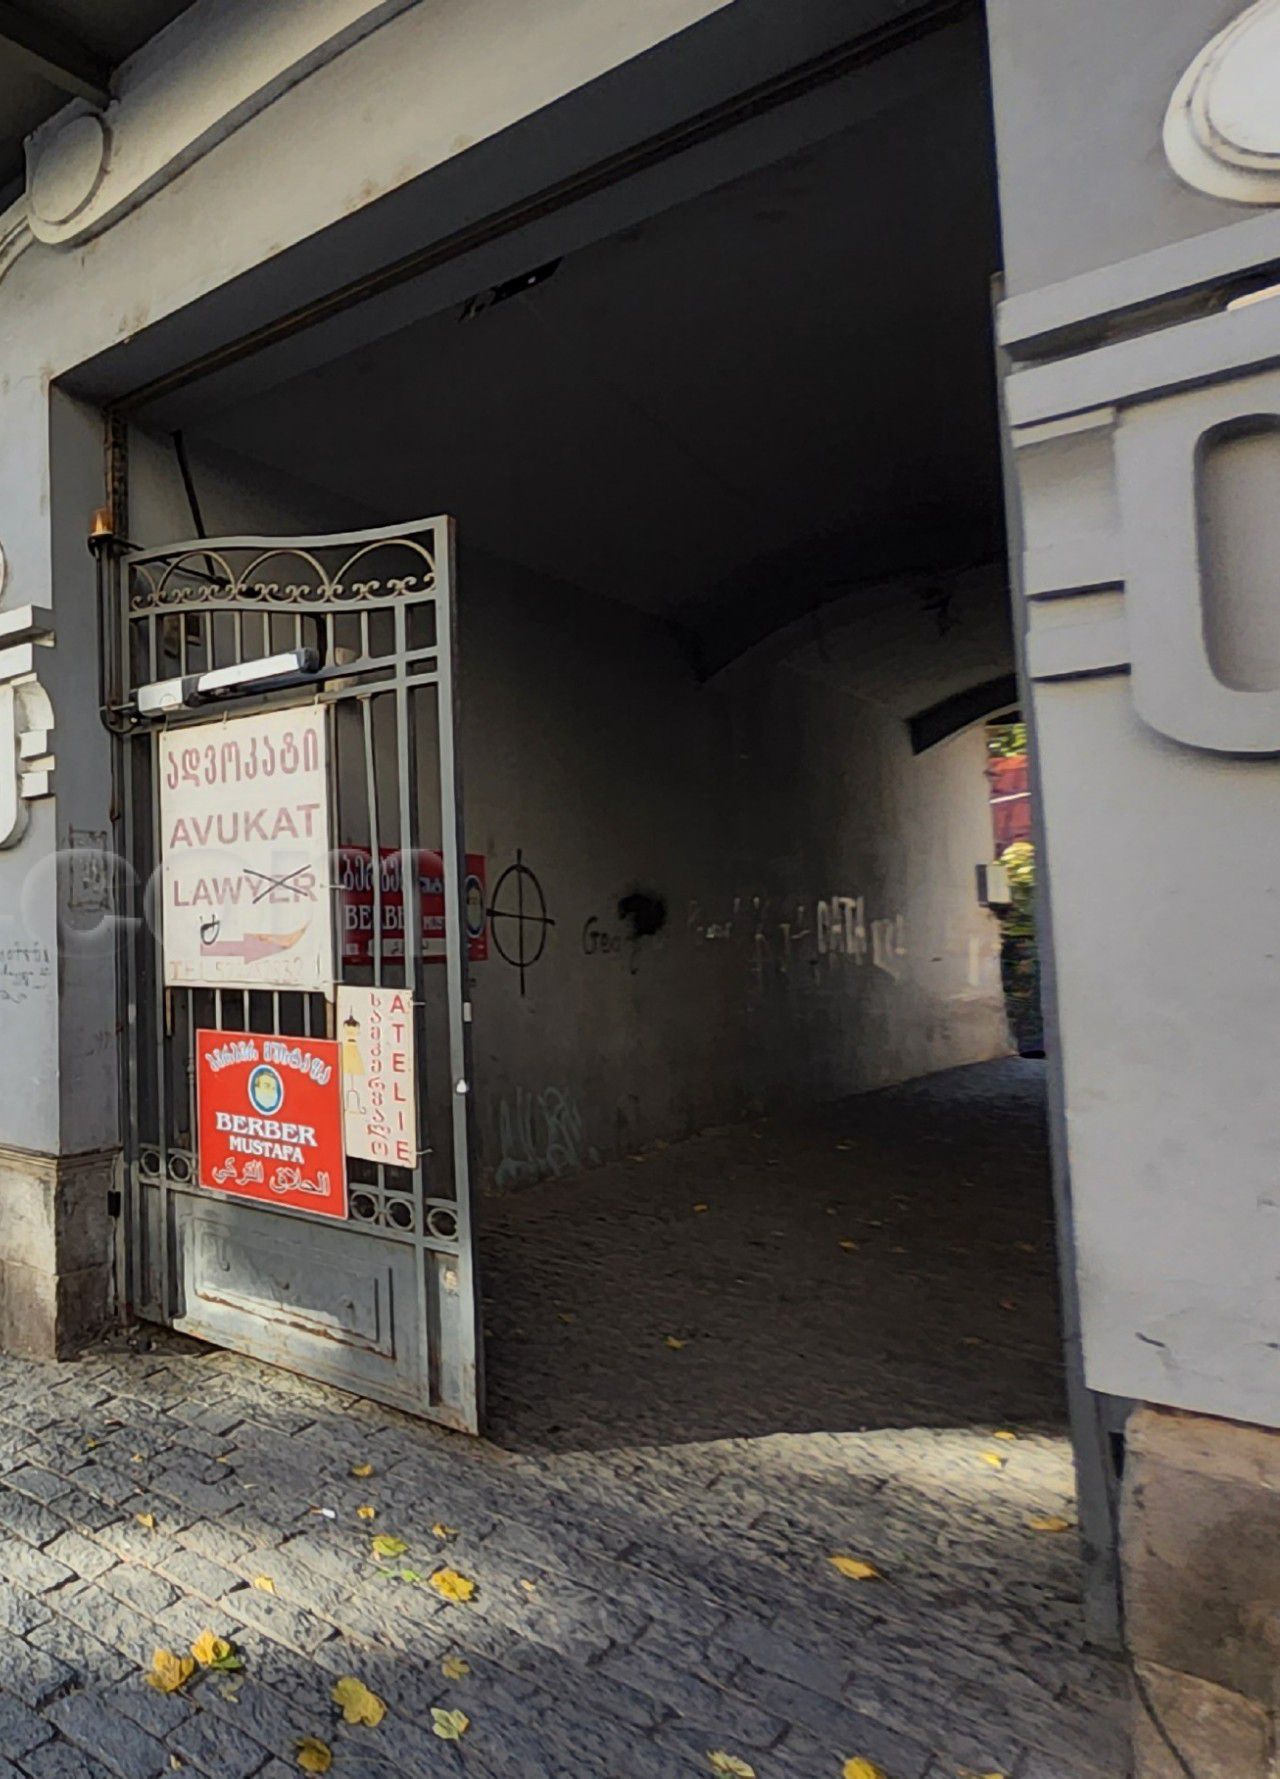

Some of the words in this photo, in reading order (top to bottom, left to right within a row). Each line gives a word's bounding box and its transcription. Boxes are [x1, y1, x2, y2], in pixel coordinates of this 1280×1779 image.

[167, 728, 319, 790] ადვოკატი
[170, 803, 320, 849] AVUKAT
[173, 871, 319, 907] LAWYER
[389, 994, 410, 1162] ATELIE
[215, 1111, 318, 1147] BERBER
[229, 1135, 305, 1164] MUSTAFA
